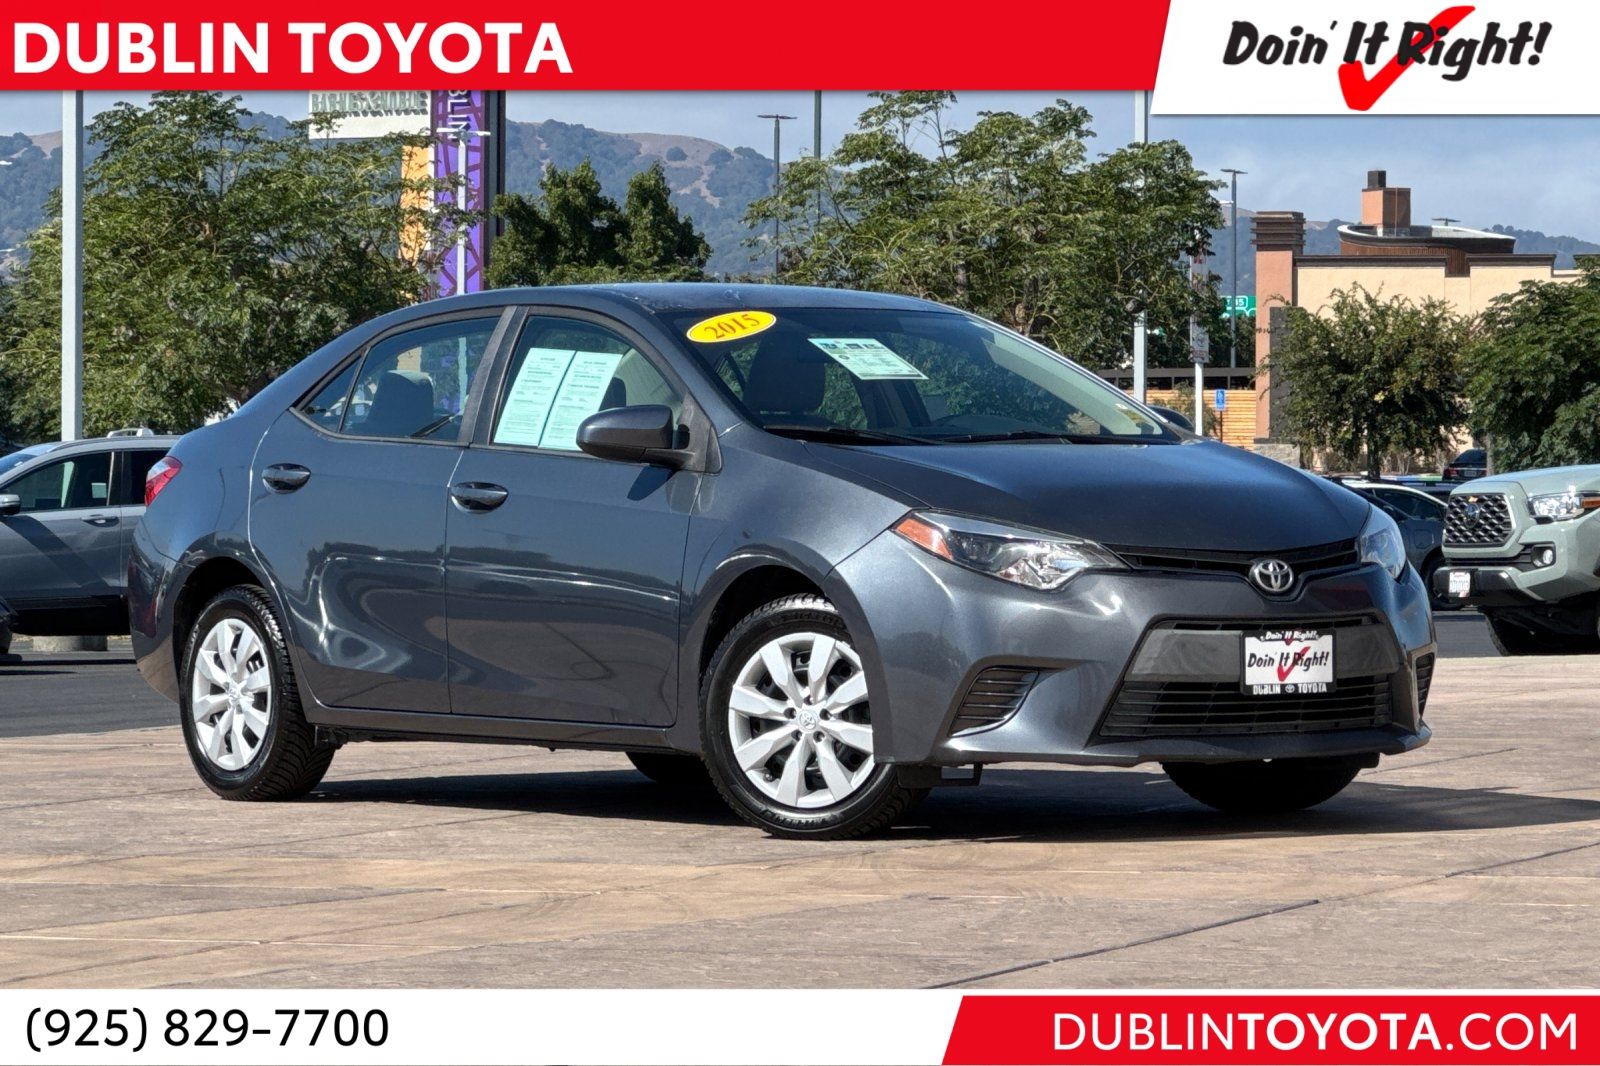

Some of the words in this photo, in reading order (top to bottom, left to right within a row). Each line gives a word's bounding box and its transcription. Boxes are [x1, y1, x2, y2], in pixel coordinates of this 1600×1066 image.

[704, 314, 761, 339] 2015
[1248, 652, 1278, 668] Doin'
[1279, 652, 1290, 666] It
[1294, 651, 1329, 672] Right!
[1253, 684, 1281, 695] DUBLIN
[1297, 683, 1327, 694] TOYOTA
